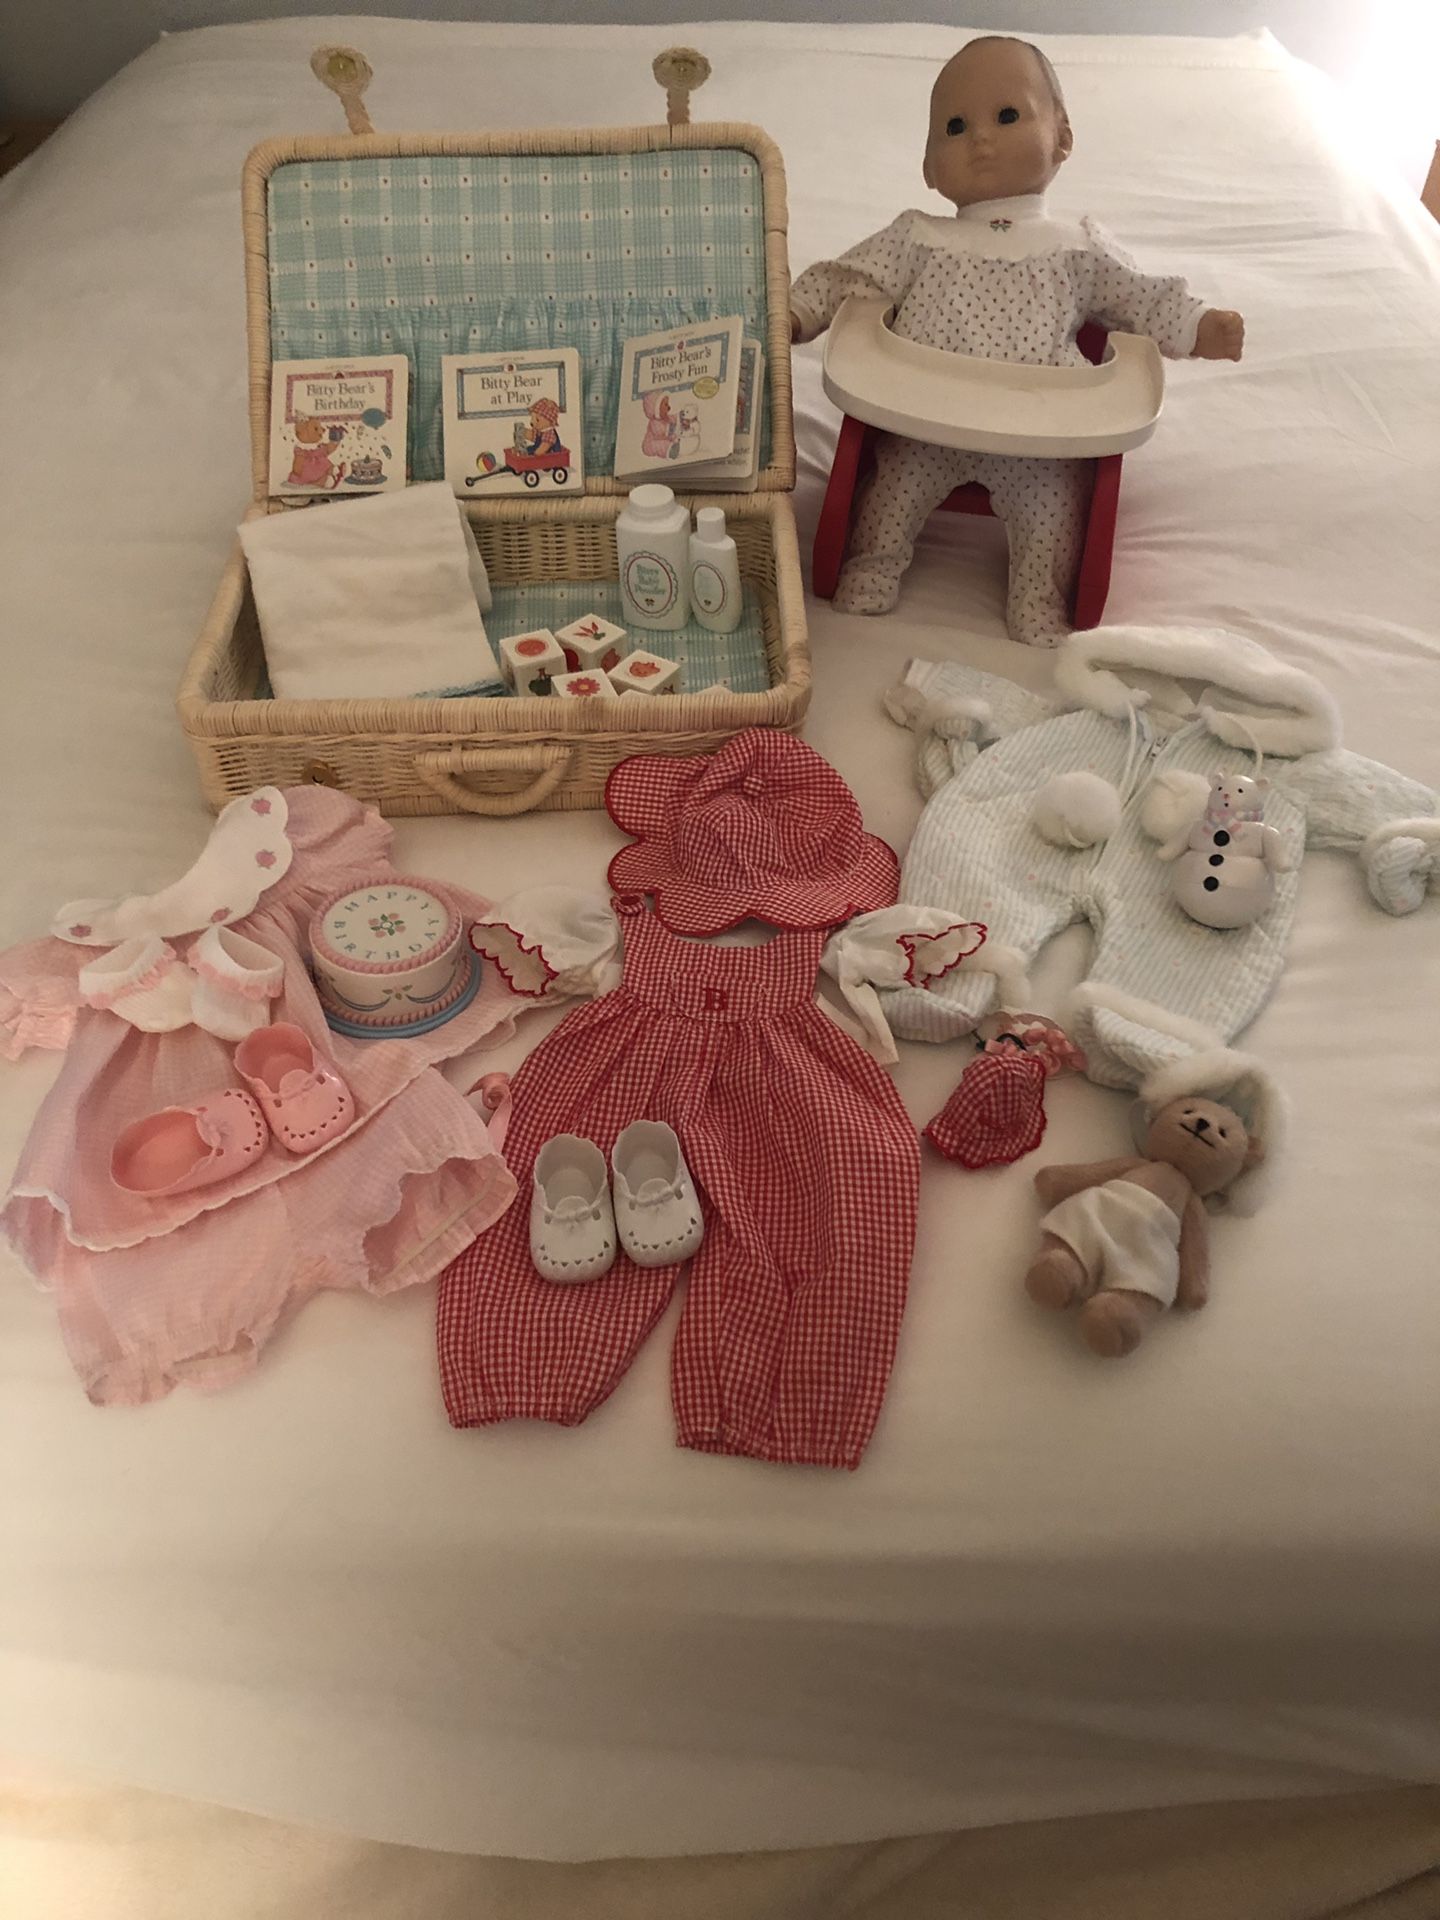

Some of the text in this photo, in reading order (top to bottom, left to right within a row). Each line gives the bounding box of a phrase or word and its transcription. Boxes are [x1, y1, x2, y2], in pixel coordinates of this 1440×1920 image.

[650, 346, 712, 370] Bitty Bear's
[481, 375, 543, 390] Bitty Bear
[652, 364, 708, 384] Frosty Fun
[306, 382, 375, 396] Bitty Bear's
[314, 398, 365, 411] Birthday
[490, 391, 533, 405] at Play
[344, 890, 431, 912] HAPPY
[333, 918, 440, 960] BIRTHDAY
